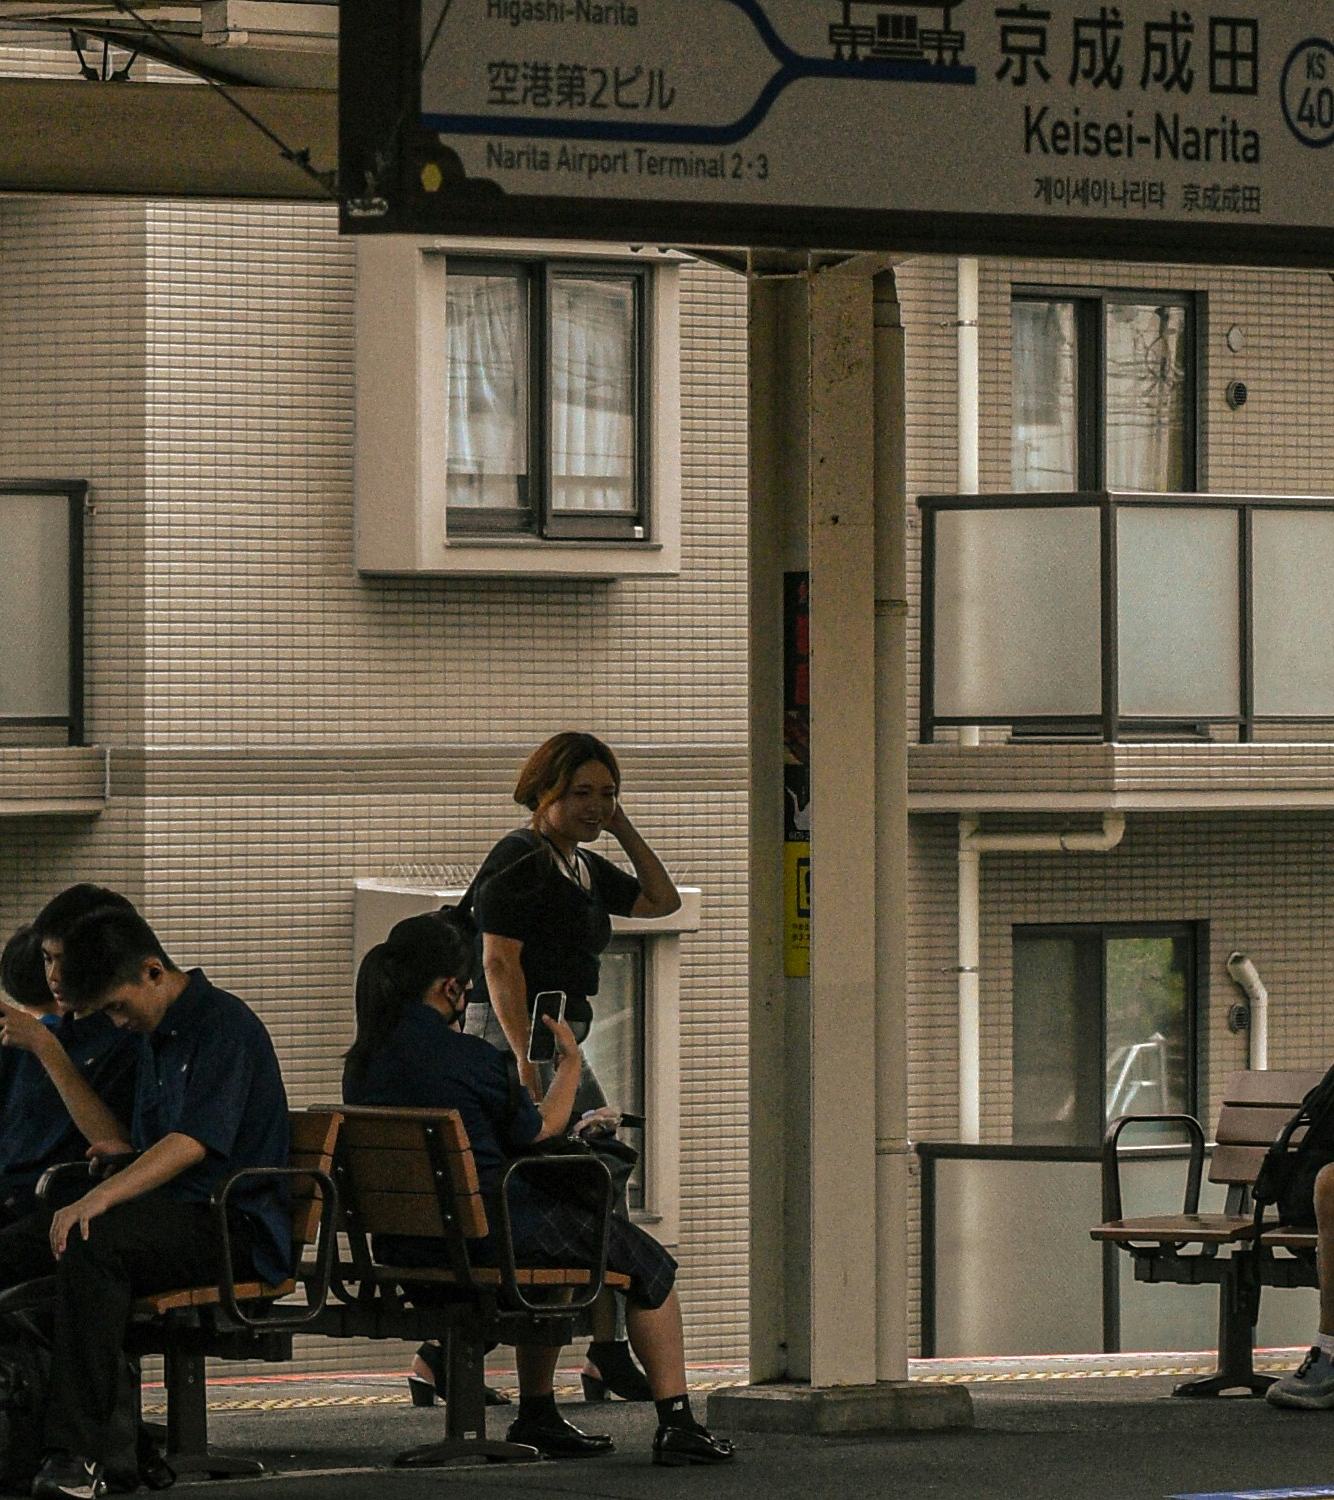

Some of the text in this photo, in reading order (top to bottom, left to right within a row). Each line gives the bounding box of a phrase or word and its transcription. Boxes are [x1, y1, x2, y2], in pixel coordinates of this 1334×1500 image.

[993, 2, 1260, 97] 京成成田
[1305, 52, 1326, 81] KS
[486, 60, 677, 112] 空港第2ビル
[1296, 86, 1334, 130] 40
[1023, 105, 1261, 164] Keisei-Narita
[486, 141, 550, 171] Narita
[556, 144, 628, 179] Airport
[633, 148, 726, 178] Terminal
